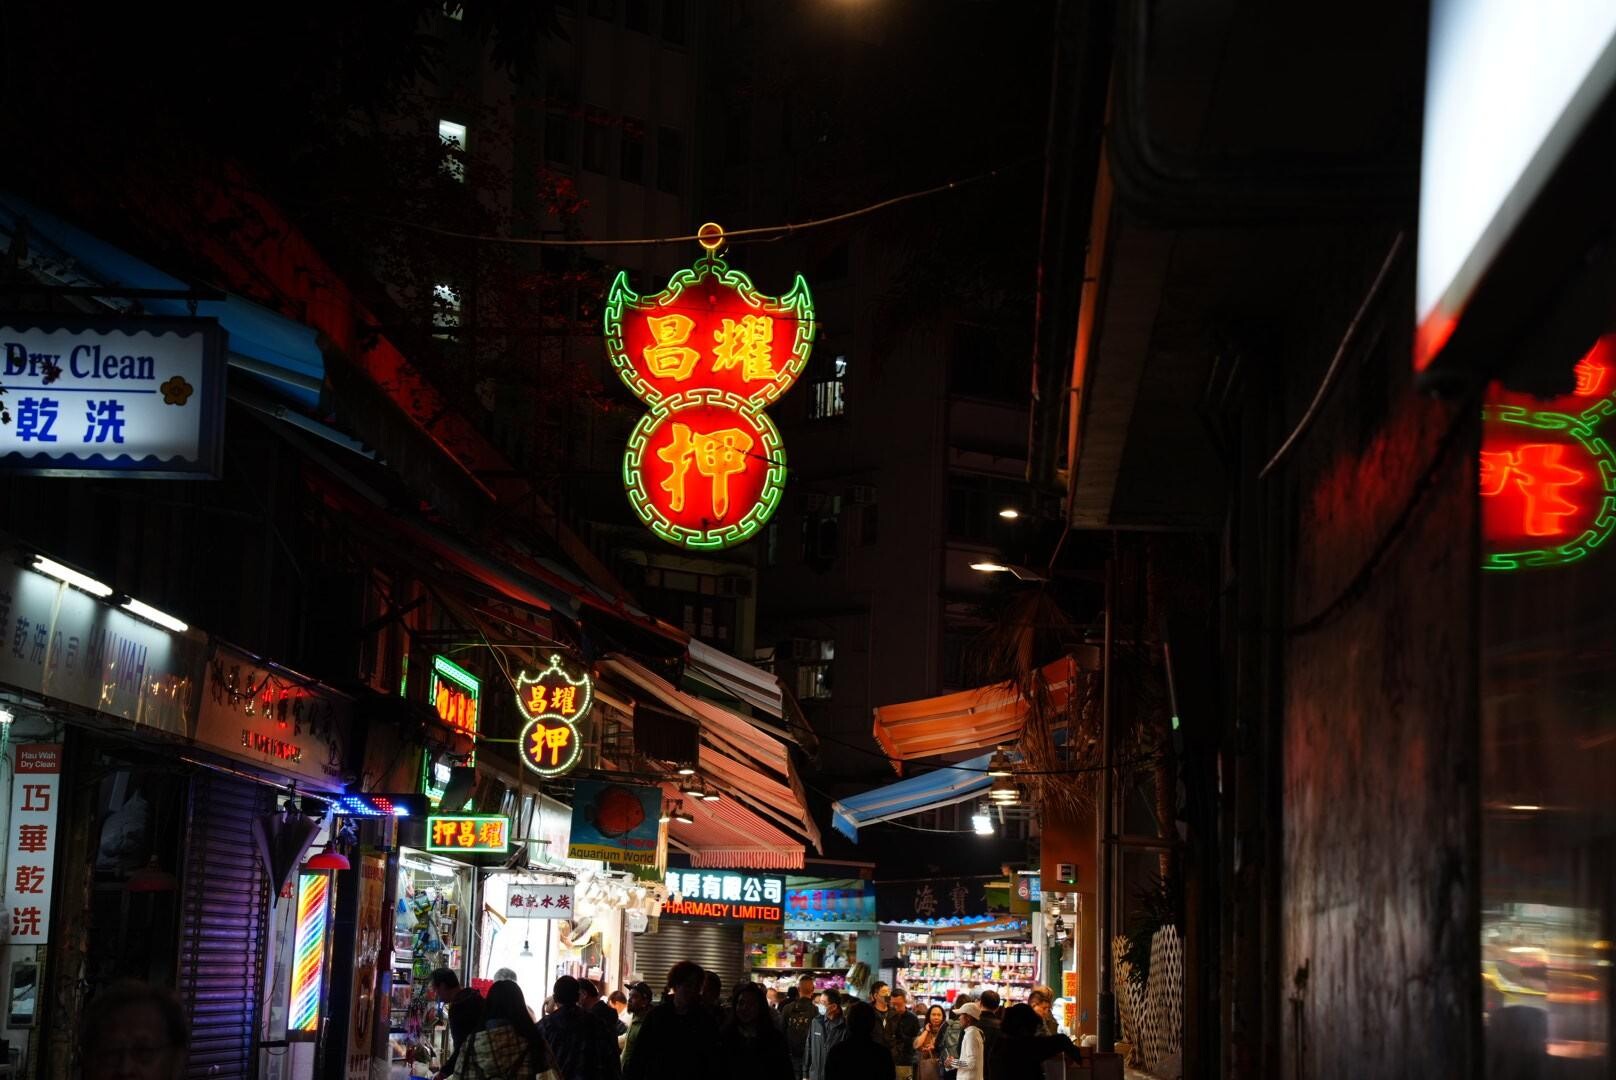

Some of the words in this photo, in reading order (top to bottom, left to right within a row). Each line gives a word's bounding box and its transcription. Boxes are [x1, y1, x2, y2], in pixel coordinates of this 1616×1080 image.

[3, 342, 61, 385] Dry
[69, 344, 156, 380] Clean
[16, 397, 125, 443] 乾洗
[656, 422, 754, 520] 押
[20, 760, 34, 770] Dry
[34, 760, 56, 769] Clean
[21, 751, 38, 760] Hau
[38, 751, 56, 760] Wah
[530, 722, 571, 766] 押
[11, 784, 51, 936] 巧華乾洗
[569, 848, 621, 862] Aquarium
[623, 850, 654, 864] World
[732, 904, 780, 920] LIMITED
